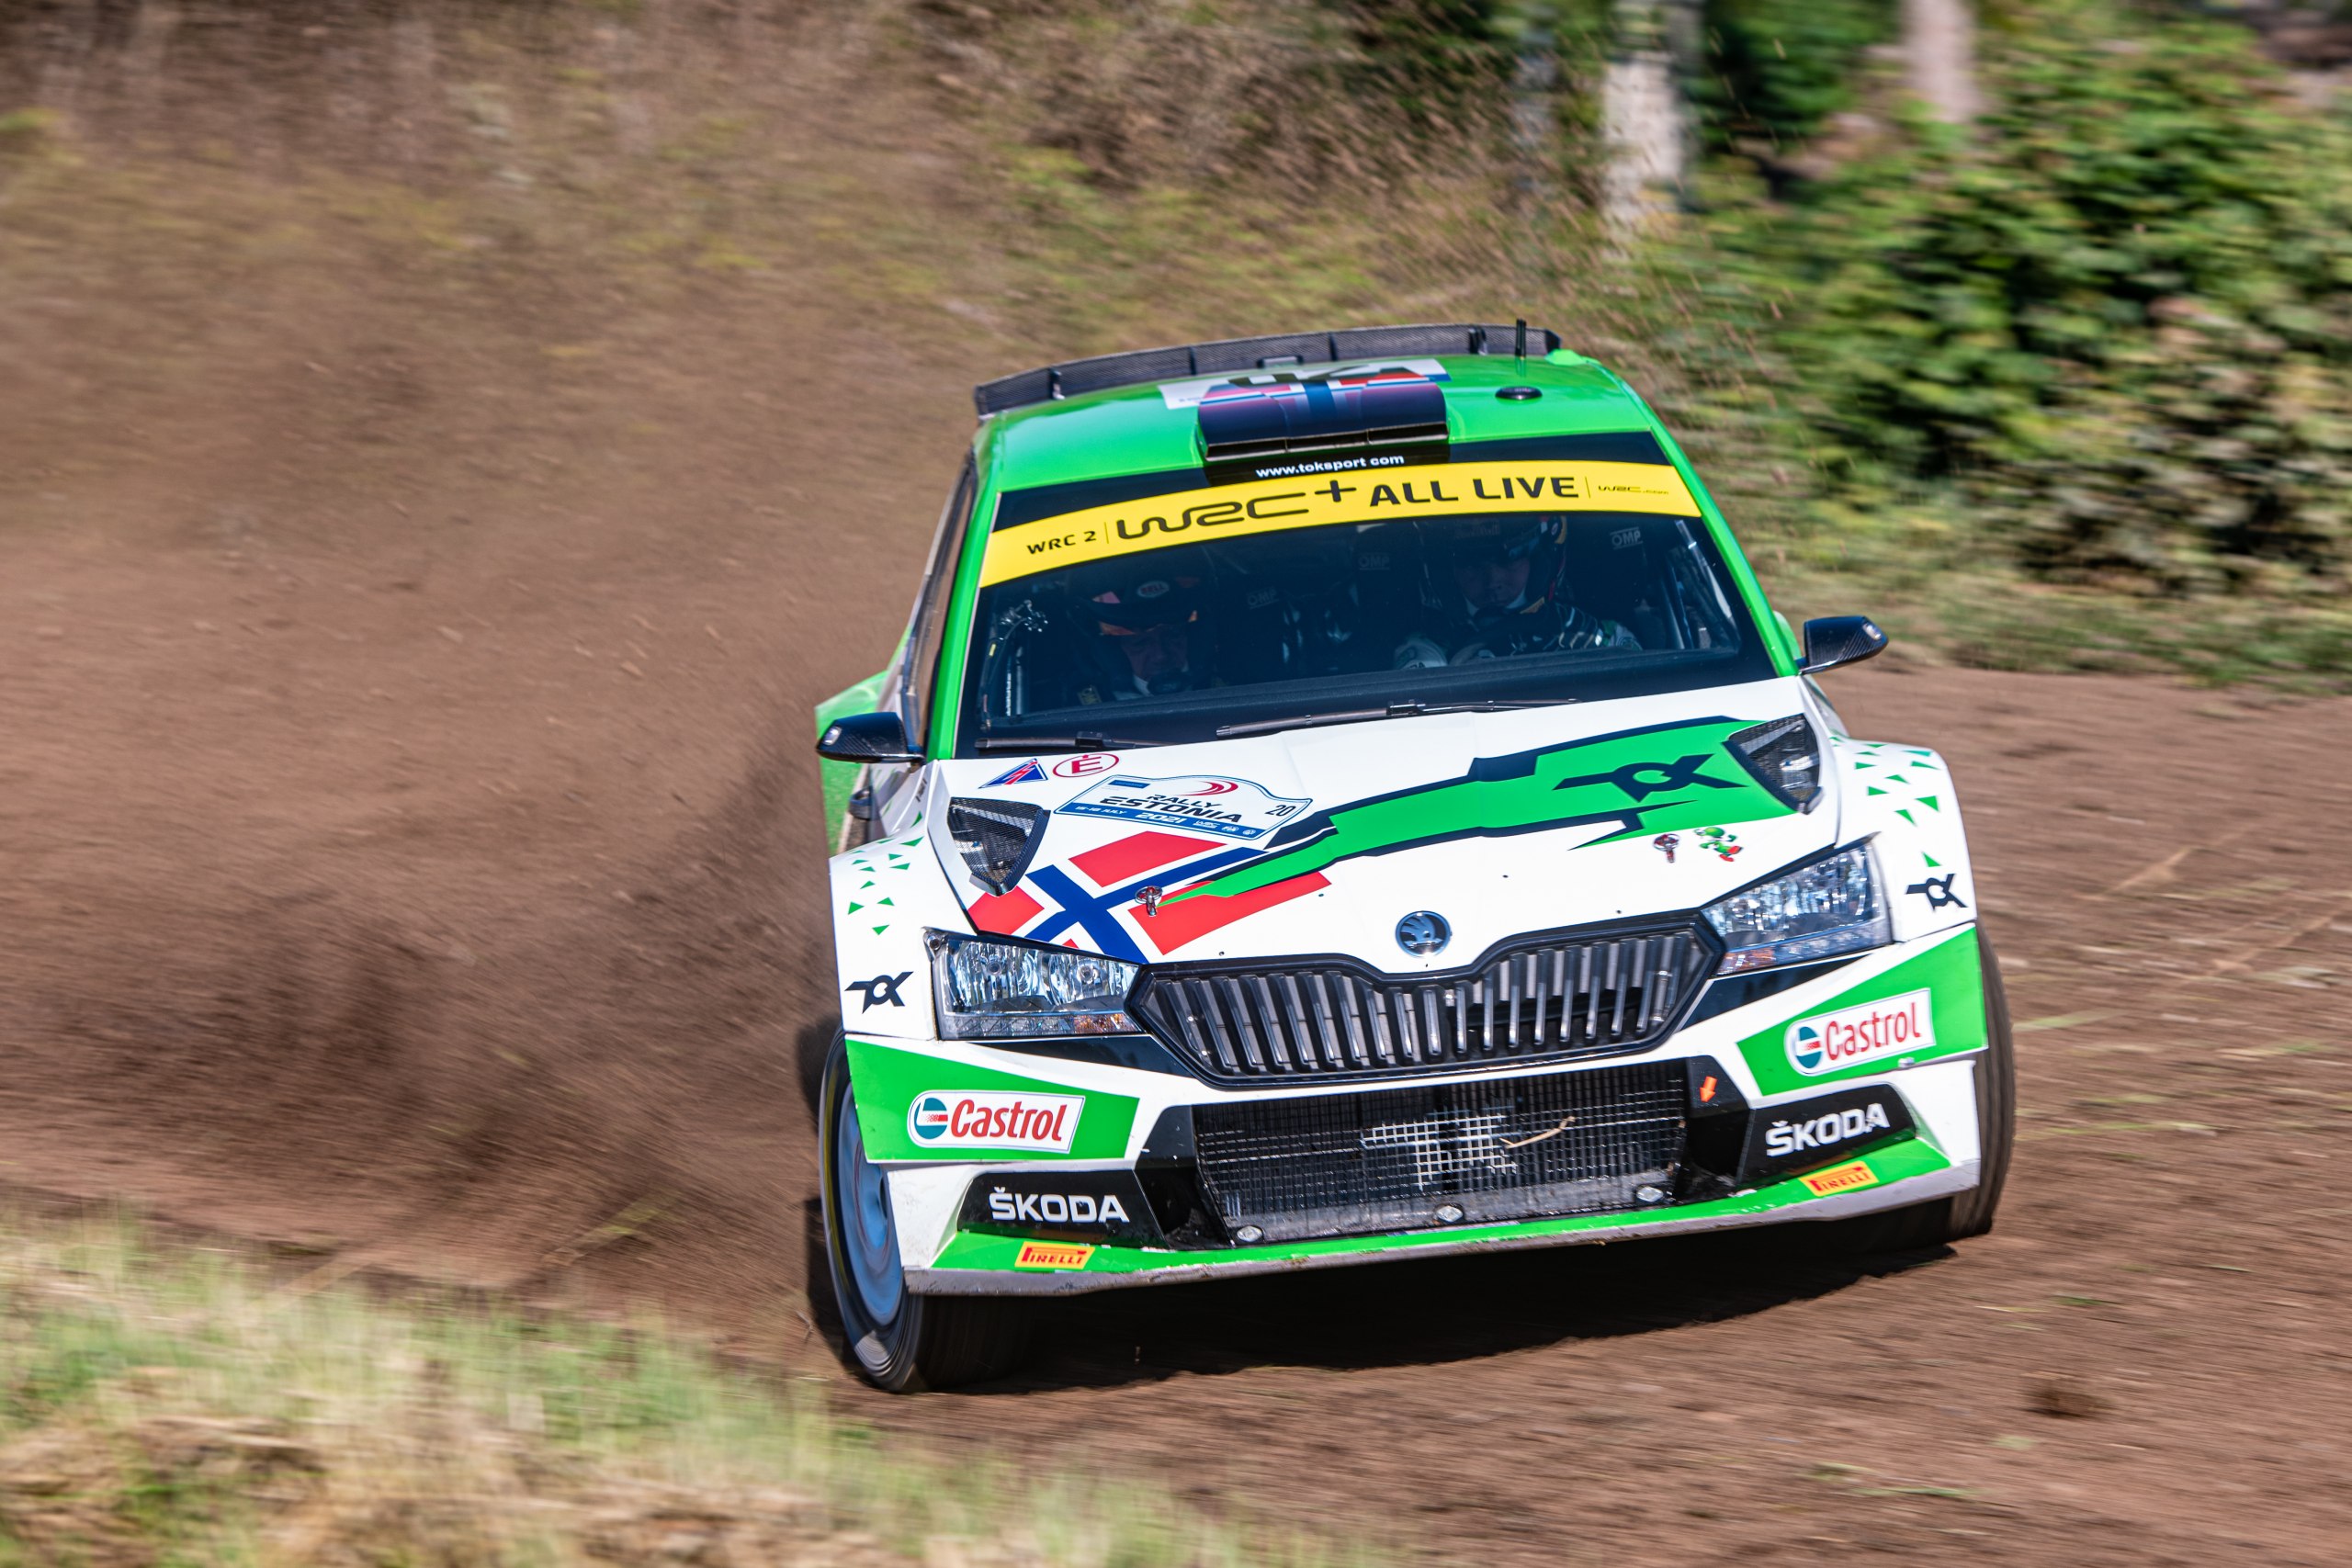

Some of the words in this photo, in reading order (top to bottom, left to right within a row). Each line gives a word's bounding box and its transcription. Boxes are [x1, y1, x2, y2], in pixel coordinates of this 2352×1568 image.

[1256, 454, 1405, 478] www.toksportcom
[1370, 479, 1459, 507] ALL
[1473, 476, 1579, 500] LIVE
[1027, 534, 1076, 555] WRC
[1084, 530, 1097, 543] 2
[1611, 529, 1642, 547] OMP
[1358, 556, 1390, 568] OMP
[1248, 588, 1277, 606] OMP
[1100, 795, 1242, 823] ESTONIA
[1147, 794, 1222, 808] RALLY
[1265, 804, 1296, 817] 20
[1135, 812, 1187, 824] 2021
[1826, 1002, 1921, 1061] Castrol
[951, 1099, 1068, 1142] Castrol
[1766, 1103, 1890, 1157] ŠKODA
[1808, 1166, 1871, 1191] PIRELLI
[989, 1187, 1130, 1223] ŠKODA
[1022, 1247, 1087, 1265] PIRELLI
